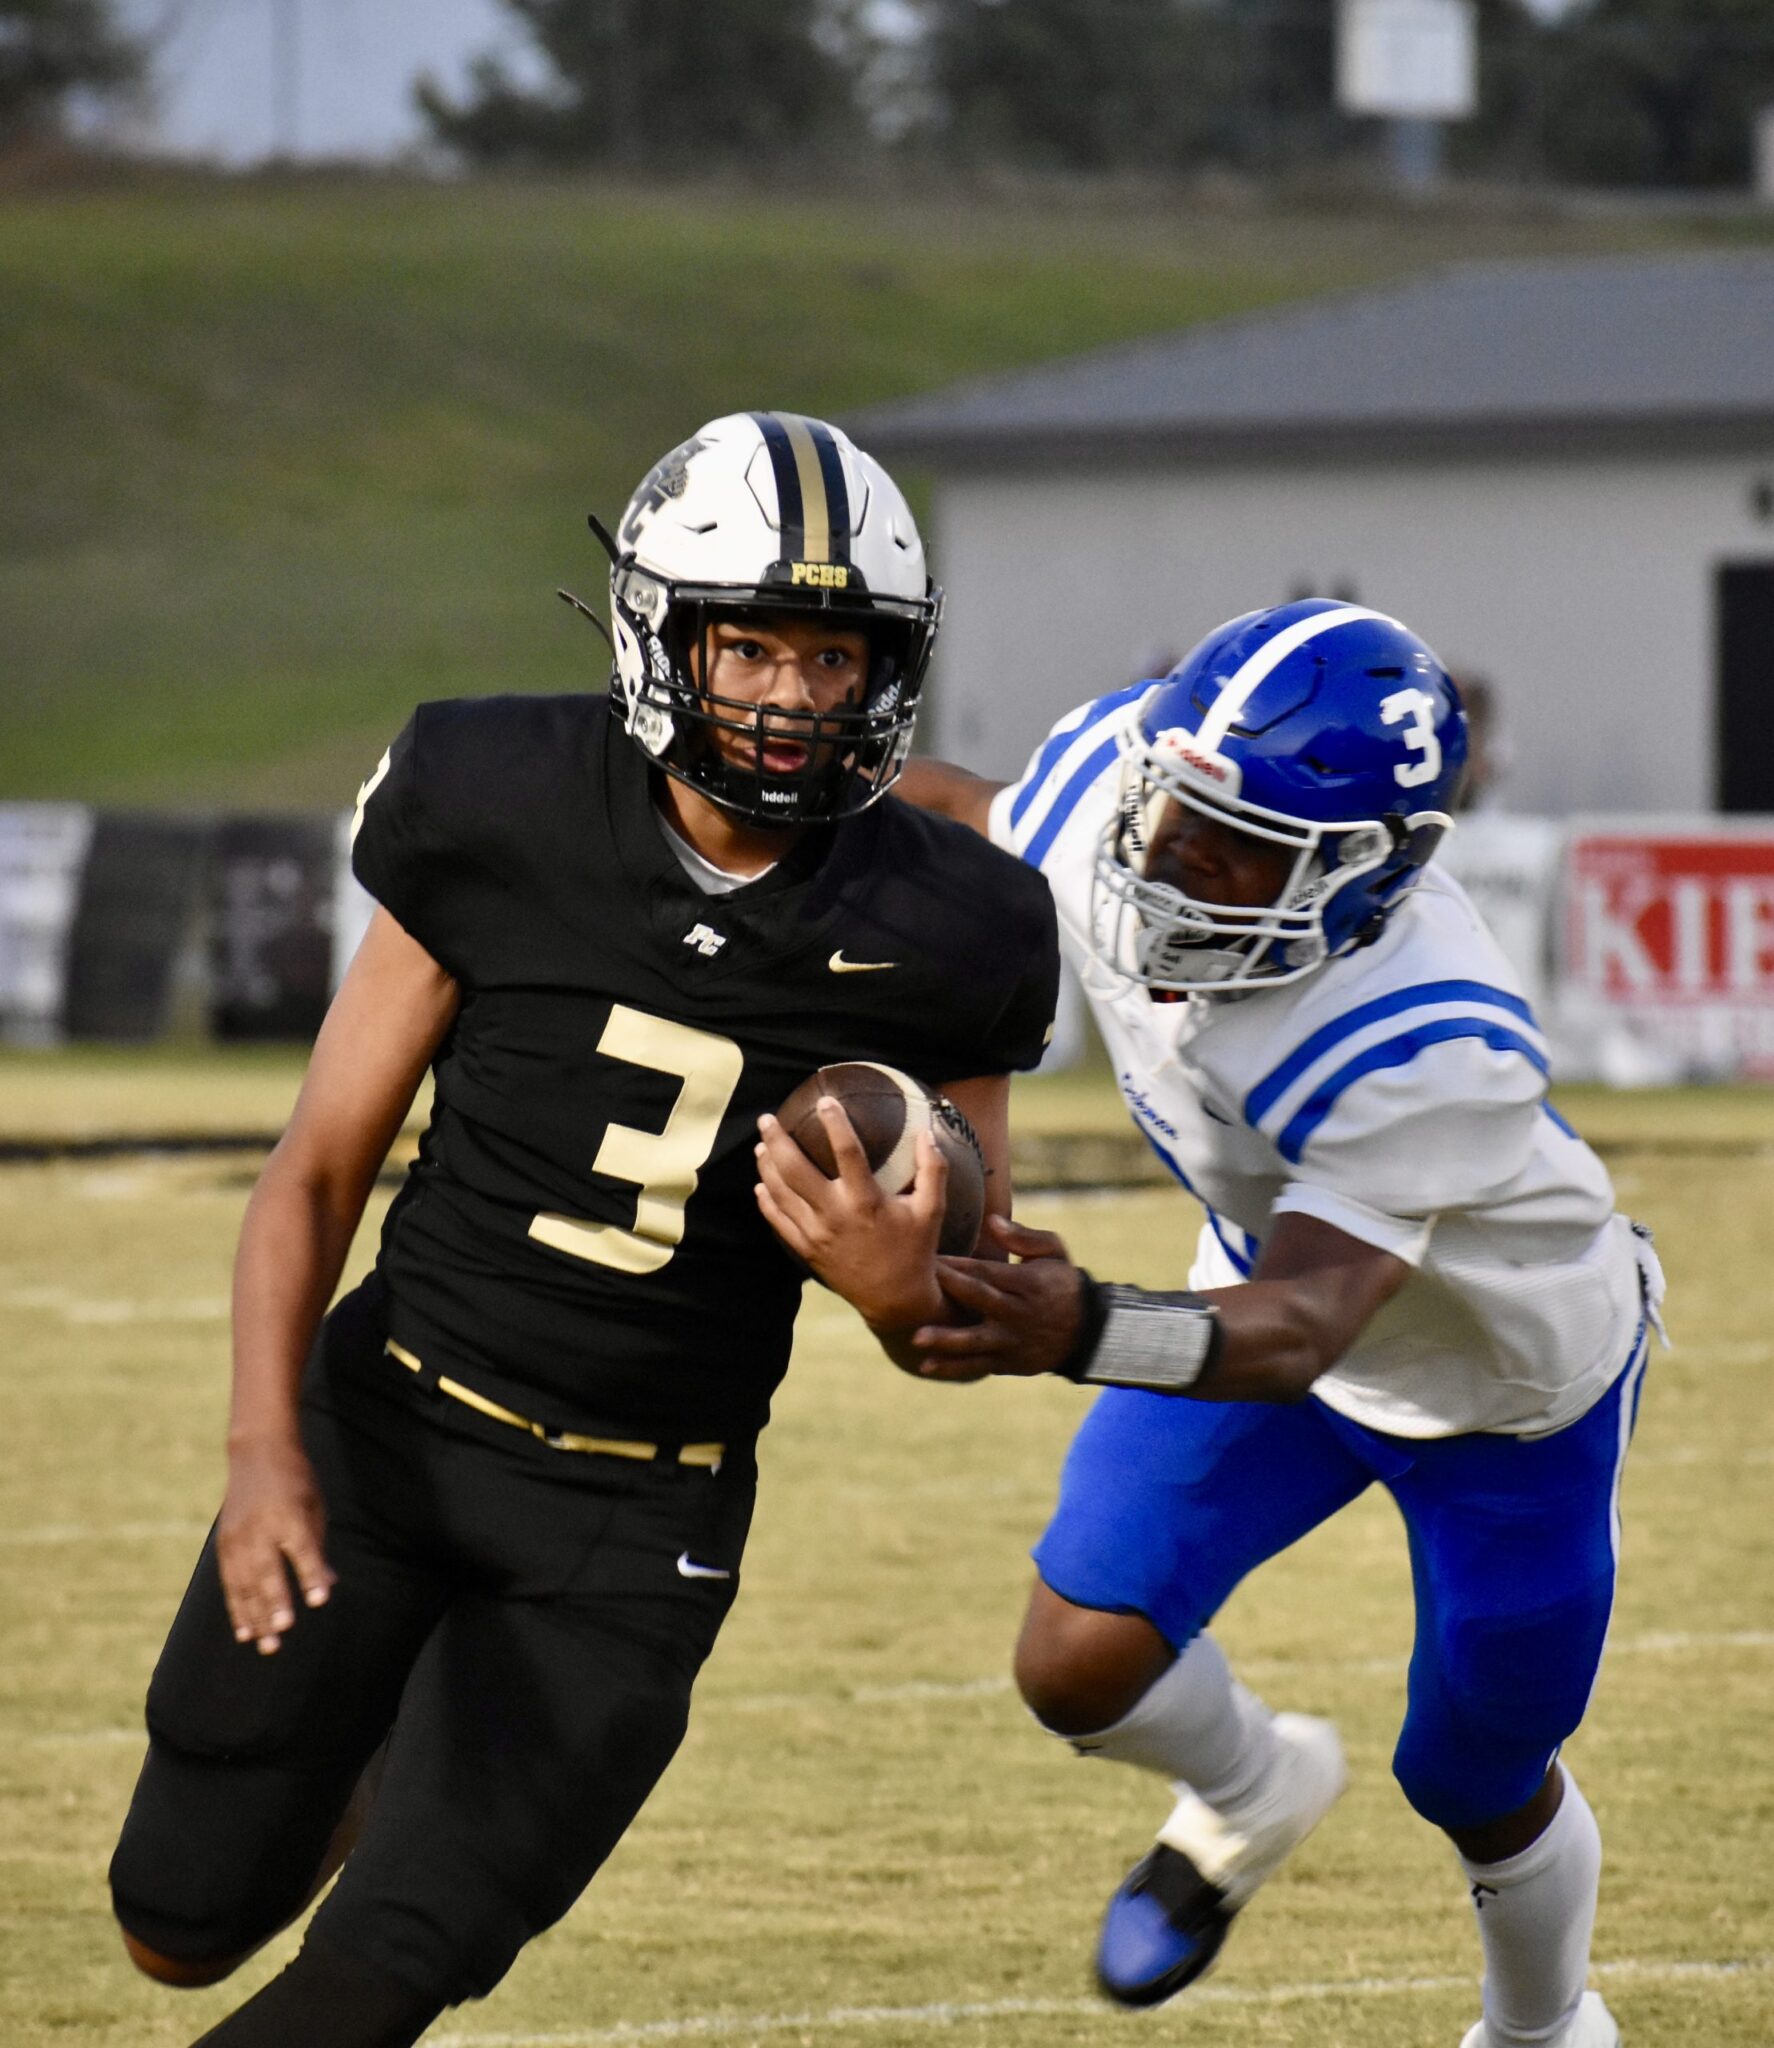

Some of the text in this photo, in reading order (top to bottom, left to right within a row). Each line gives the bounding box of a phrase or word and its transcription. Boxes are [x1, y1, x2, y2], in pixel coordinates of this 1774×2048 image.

[1379, 687, 1442, 789] 3
[682, 922, 727, 957] PC
[527, 1002, 744, 1274] 3
